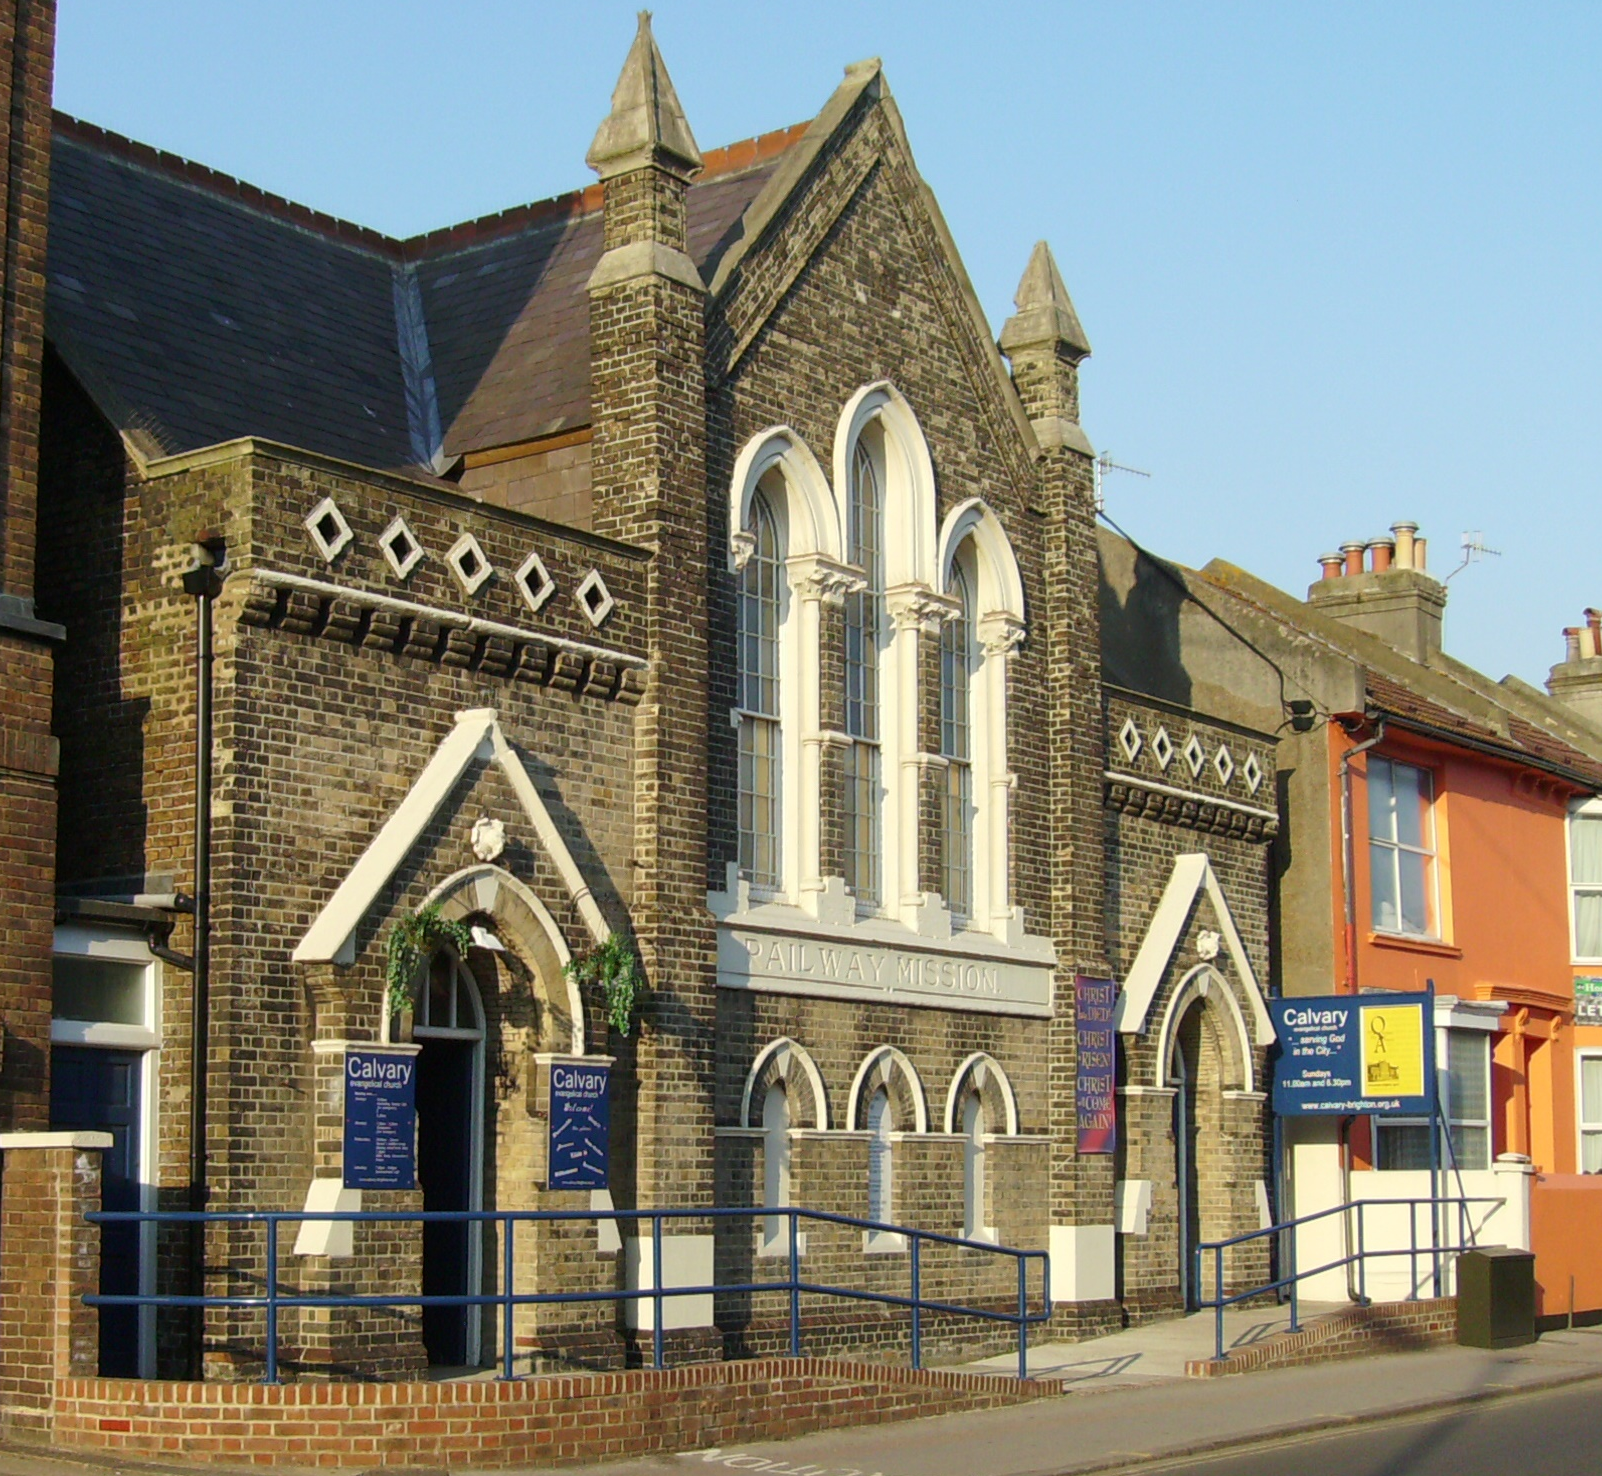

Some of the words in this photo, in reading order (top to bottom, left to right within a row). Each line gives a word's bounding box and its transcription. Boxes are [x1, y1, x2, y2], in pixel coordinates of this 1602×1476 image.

[1077, 986, 1111, 1005] CHRIST
[1283, 1008, 1348, 1027] Calvary
[1077, 1029, 1111, 1049] CHRIST
[1300, 1035, 1327, 1045] serving
[1329, 1033, 1346, 1043] God
[1293, 1047, 1300, 1056] in
[1301, 1047, 1314, 1056] the
[348, 1057, 412, 1085] Calvary
[350, 1080, 382, 1089] evangelical
[383, 1081, 402, 1089] church
[553, 1068, 607, 1095] Calvary
[1077, 1075, 1111, 1094] CHRIST
[1312, 1079, 1325, 1087] and
[1085, 1096, 1112, 1111] COME
